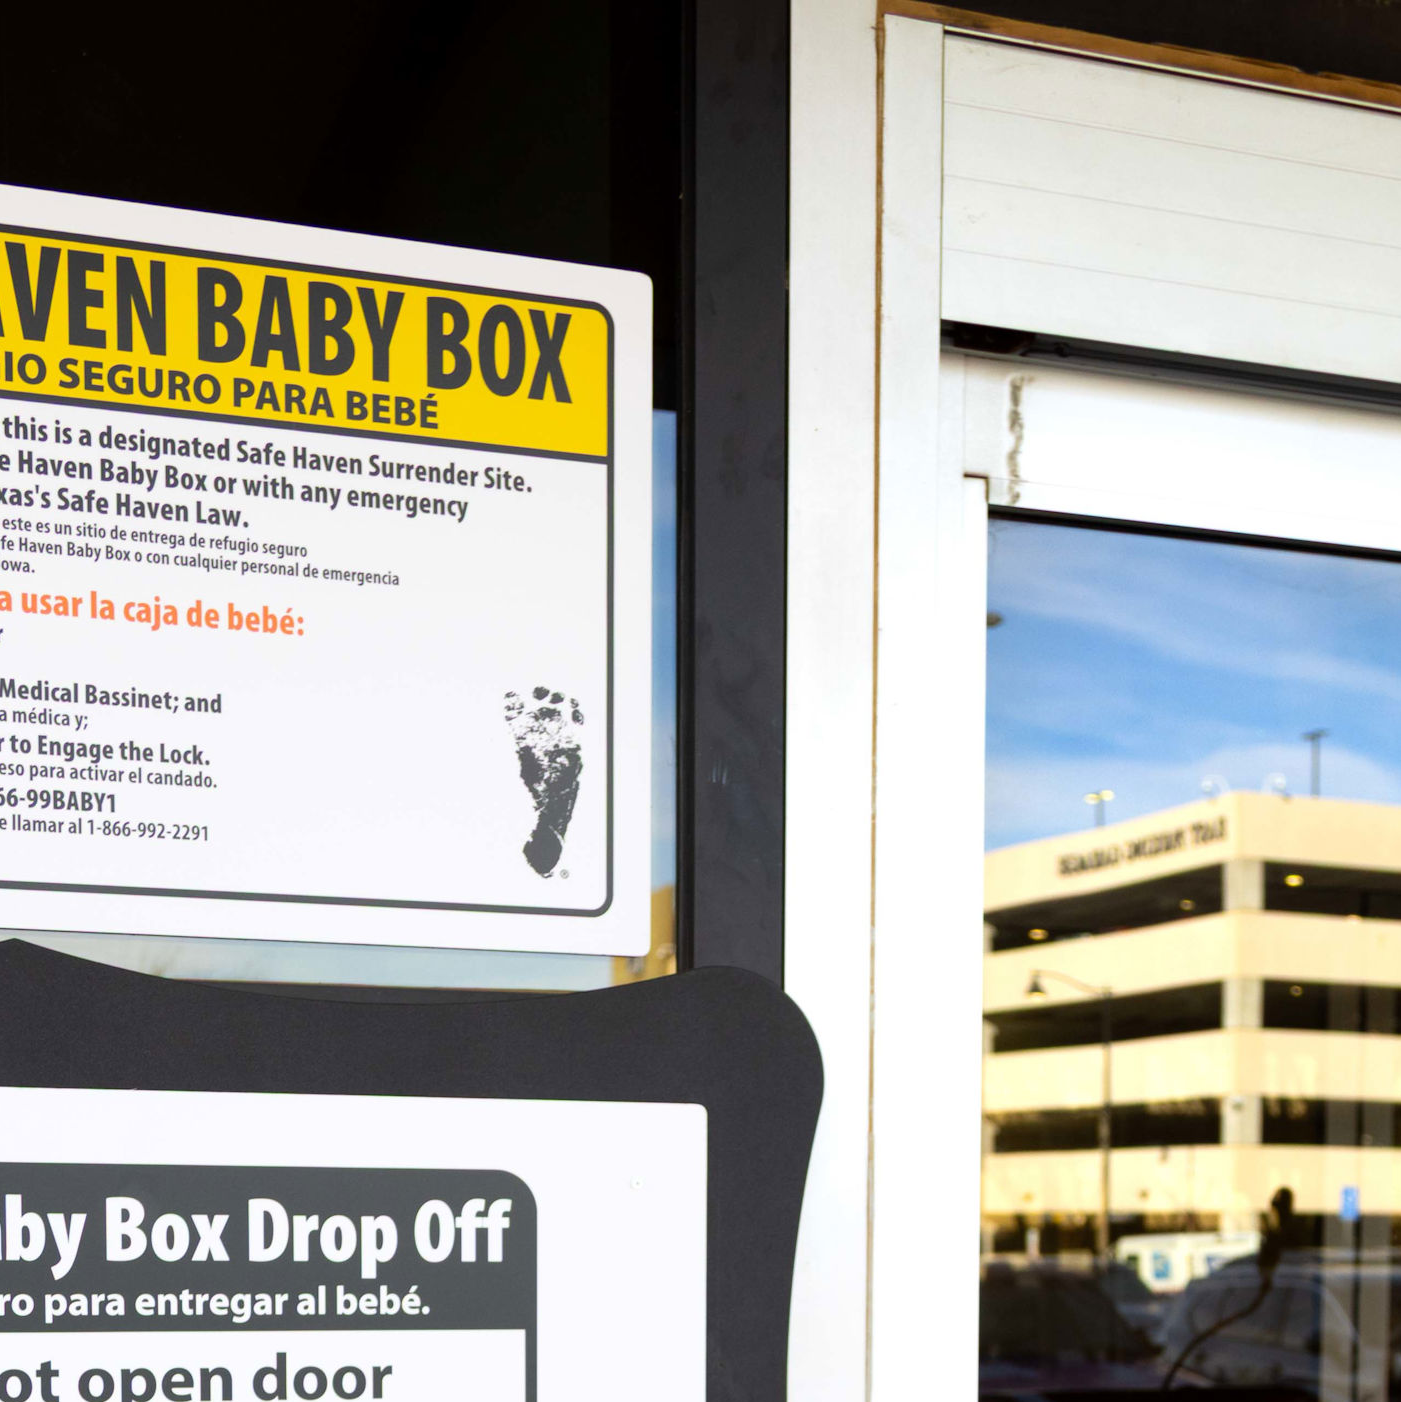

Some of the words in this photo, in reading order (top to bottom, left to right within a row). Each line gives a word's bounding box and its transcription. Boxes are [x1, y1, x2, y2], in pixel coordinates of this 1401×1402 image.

[198, 267, 405, 382] BABY
[427, 297, 572, 403] BOX
[59, 358, 221, 404] SEGURO
[234, 378, 334, 417] PARA
[347, 391, 438, 429] BEBÉ
[3, 416, 47, 441] this
[55, 420, 72, 444] is
[79, 430, 91, 446] a
[99, 426, 229, 461] designated
[237, 441, 285, 466] Safe
[294, 447, 361, 474] Haven
[369, 455, 478, 486] Surrender
[485, 467, 531, 492] Site.
[21, 592, 83, 617] usar
[90, 590, 115, 620] la
[123, 596, 178, 631] caja
[186, 600, 219, 629] de
[228, 602, 304, 636] bebé:
[13, 815, 63, 832] llamar
[69, 818, 81, 833] al
[88, 820, 207, 840] 1-866-992-2291
[106, 1197, 230, 1262] Box
[248, 1198, 398, 1279] Drop
[414, 1198, 512, 1262] Off
[45, 1294, 125, 1323] para
[135, 1289, 288, 1323] entregar
[297, 1285, 326, 1315] al
[337, 1285, 430, 1315] bebé.
[253, 1353, 392, 1401] door
